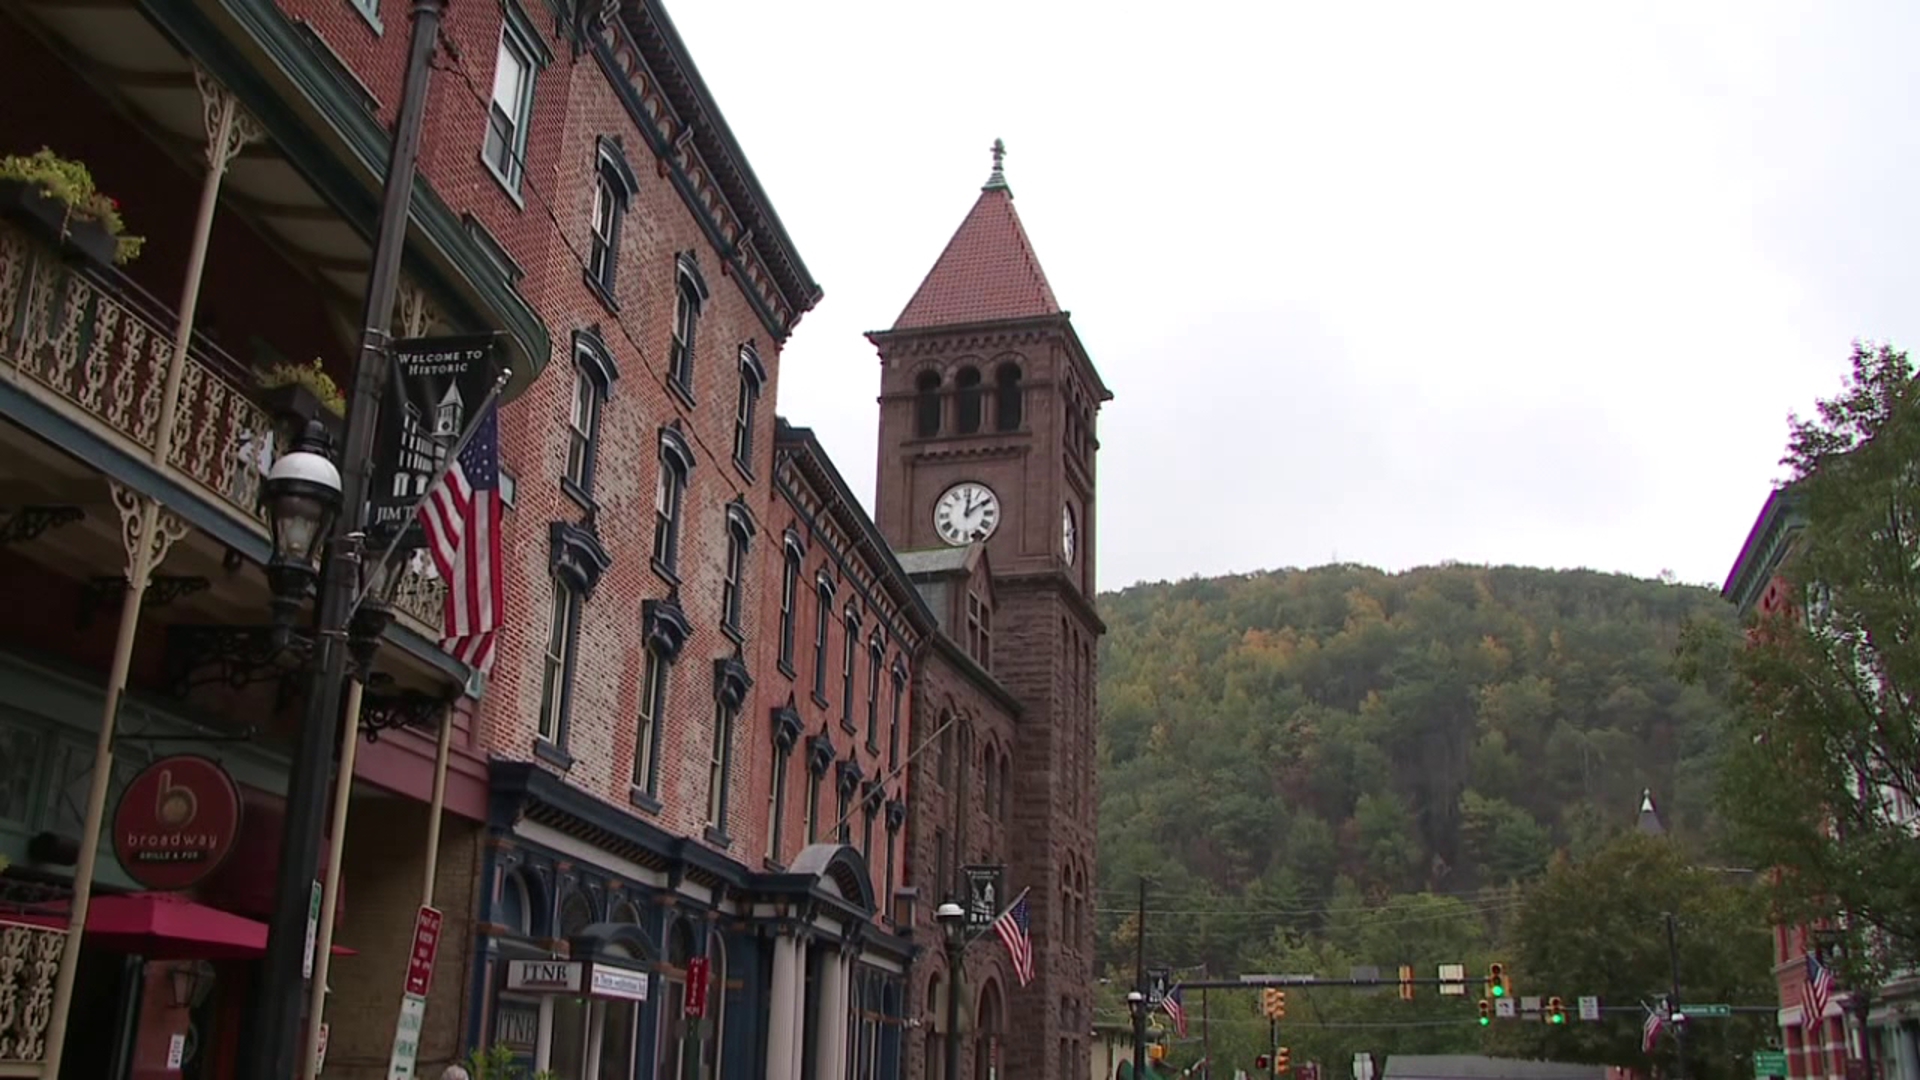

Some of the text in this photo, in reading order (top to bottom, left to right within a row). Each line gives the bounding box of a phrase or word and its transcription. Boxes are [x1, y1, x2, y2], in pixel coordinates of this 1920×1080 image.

[398, 350, 483, 364] WELCOME TO
[408, 362, 469, 376] HISTORIC
[375, 506, 402, 525] JIM
[127, 832, 218, 849] broadway
